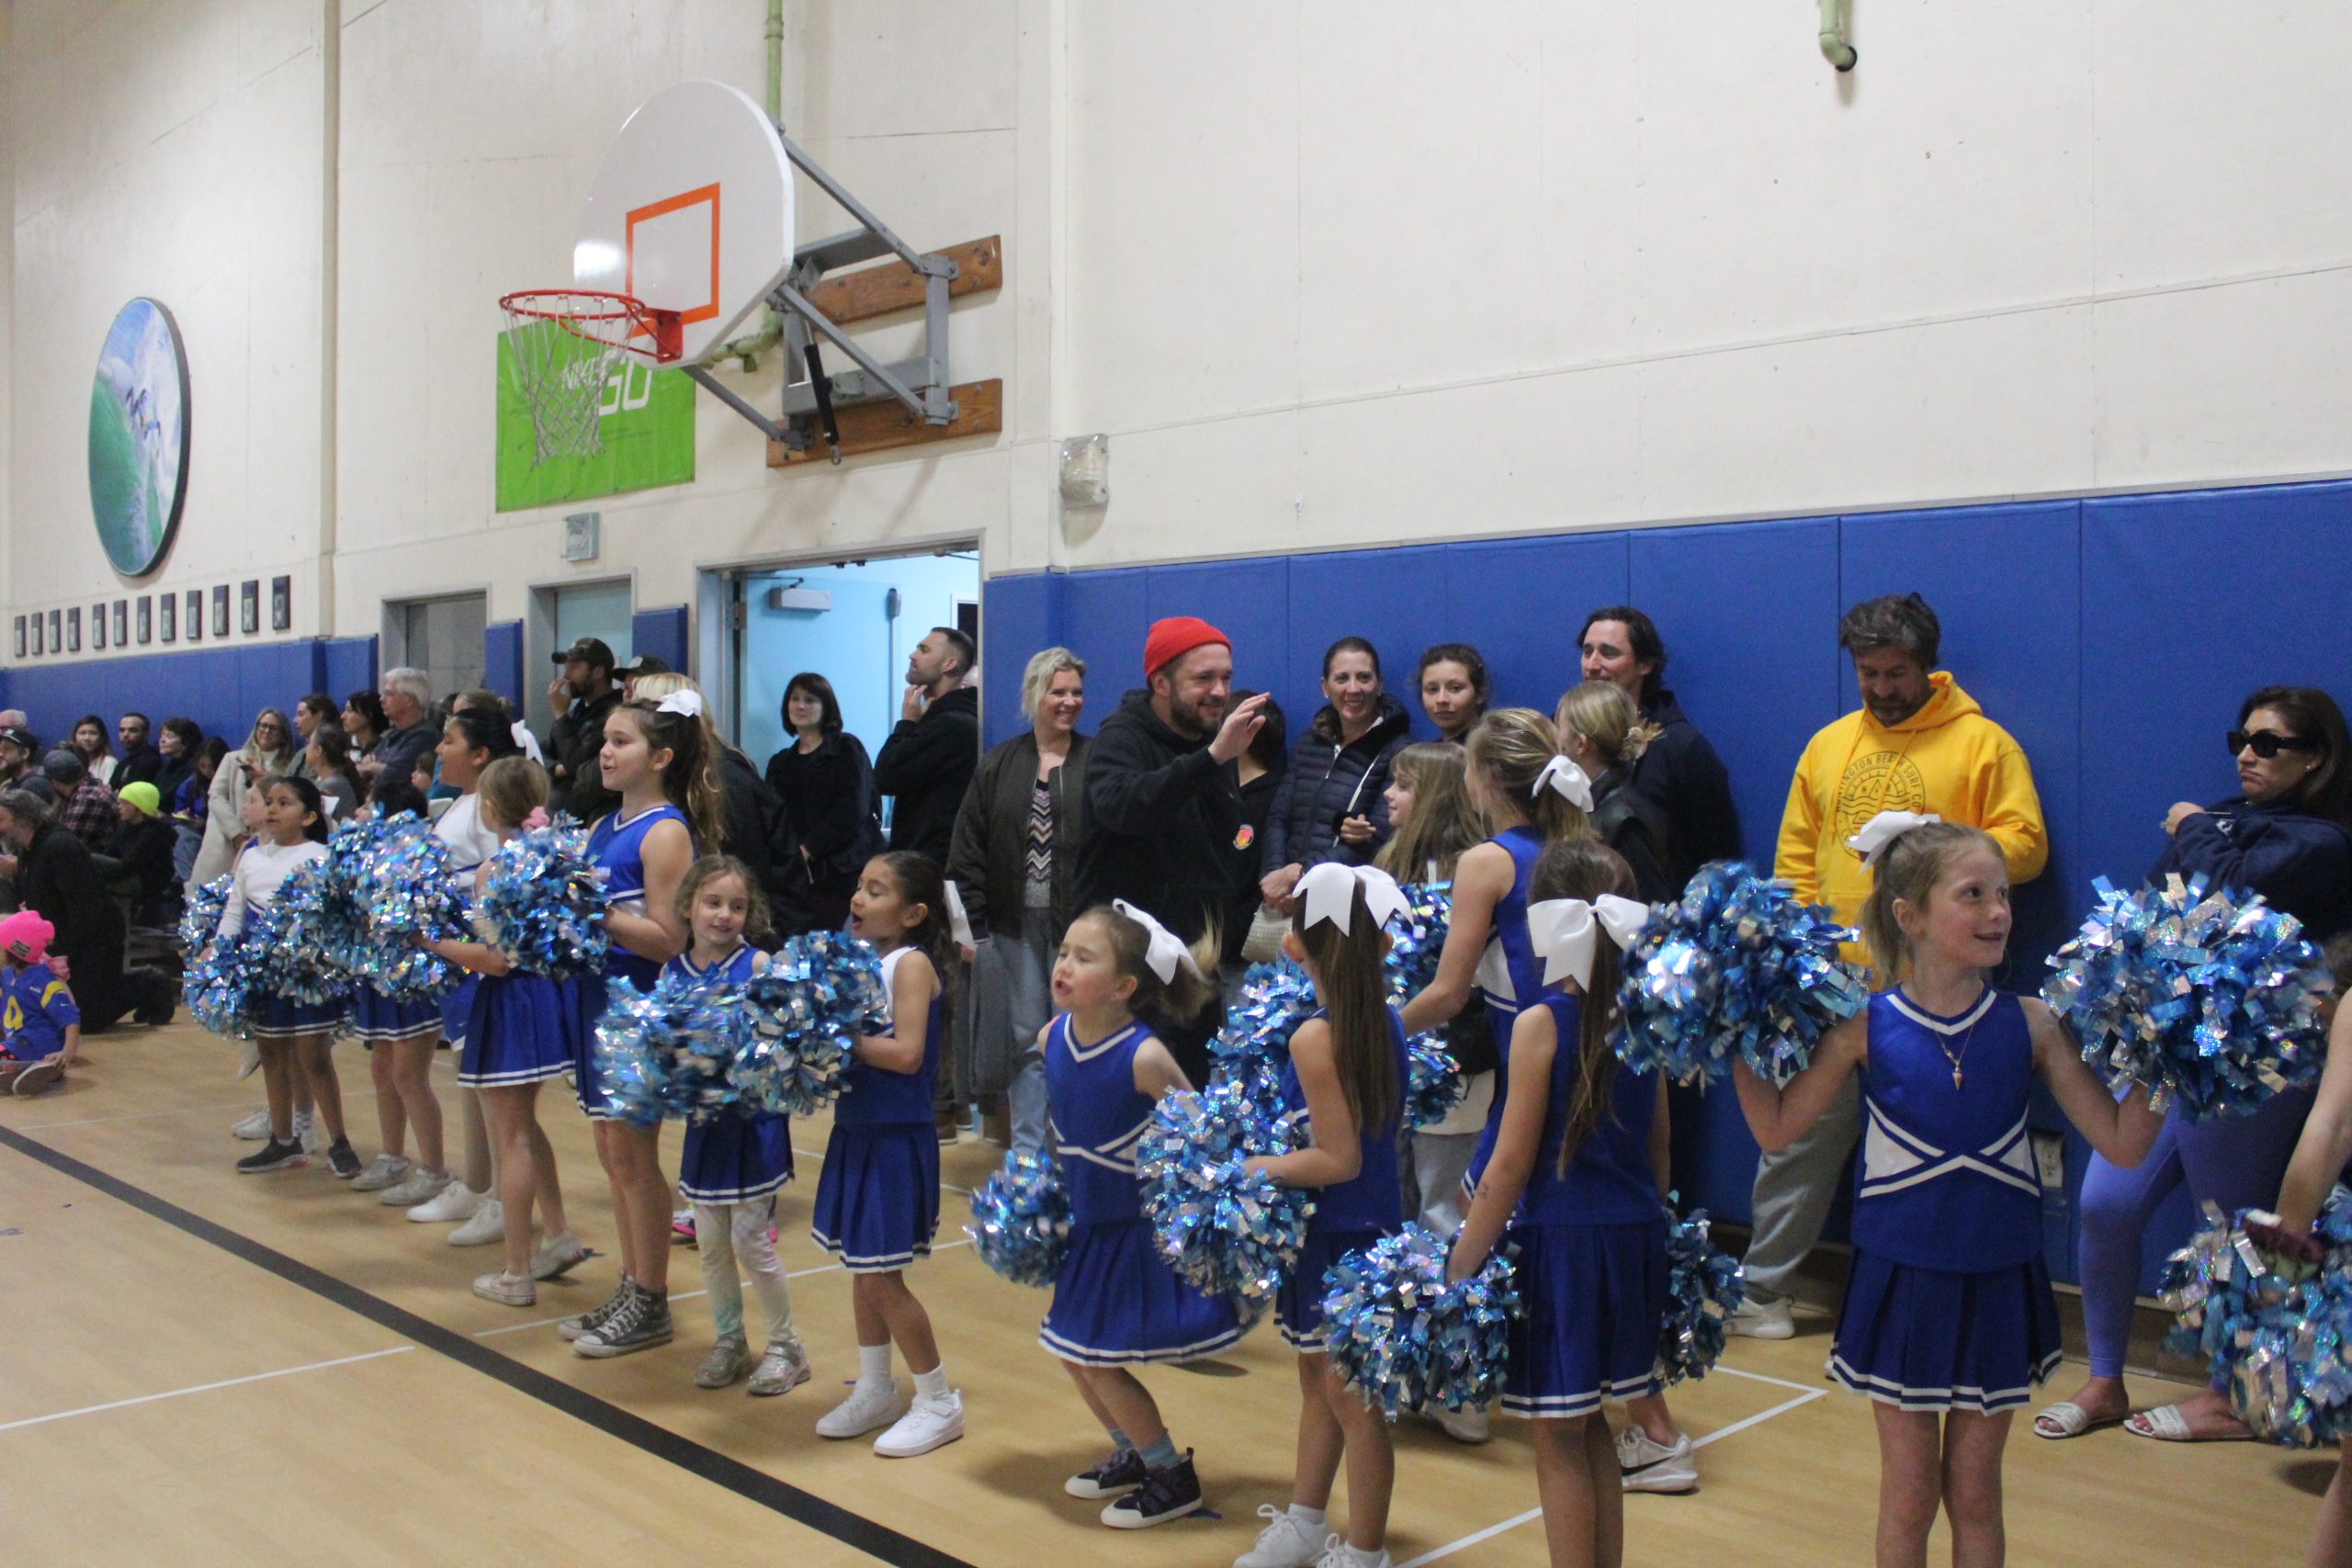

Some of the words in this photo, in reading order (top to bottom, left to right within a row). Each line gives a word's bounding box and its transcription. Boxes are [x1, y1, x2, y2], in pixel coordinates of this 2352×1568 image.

[1876, 754, 1905, 767] BEAH
[1903, 765, 1921, 788] SURF
[1911, 794, 1922, 808] CO
